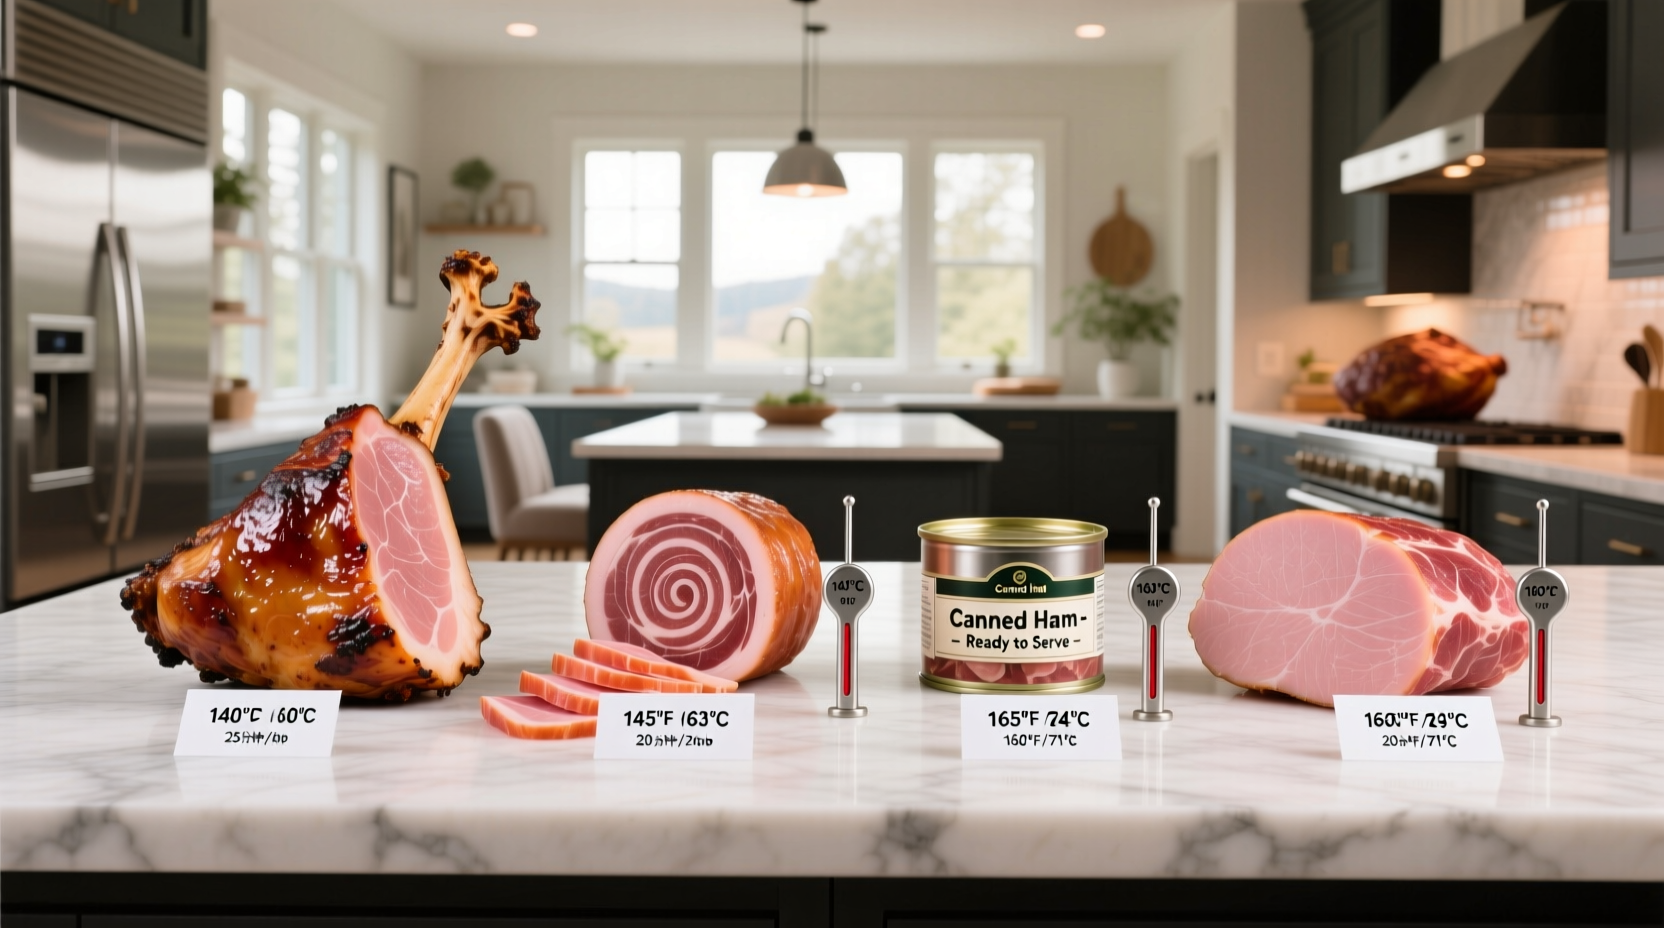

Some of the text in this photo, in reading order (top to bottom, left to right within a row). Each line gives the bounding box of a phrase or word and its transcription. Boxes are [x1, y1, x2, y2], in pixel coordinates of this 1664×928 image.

[949, 608, 1027, 630] Canned
[966, 634, 1070, 653] Ready to Serve
